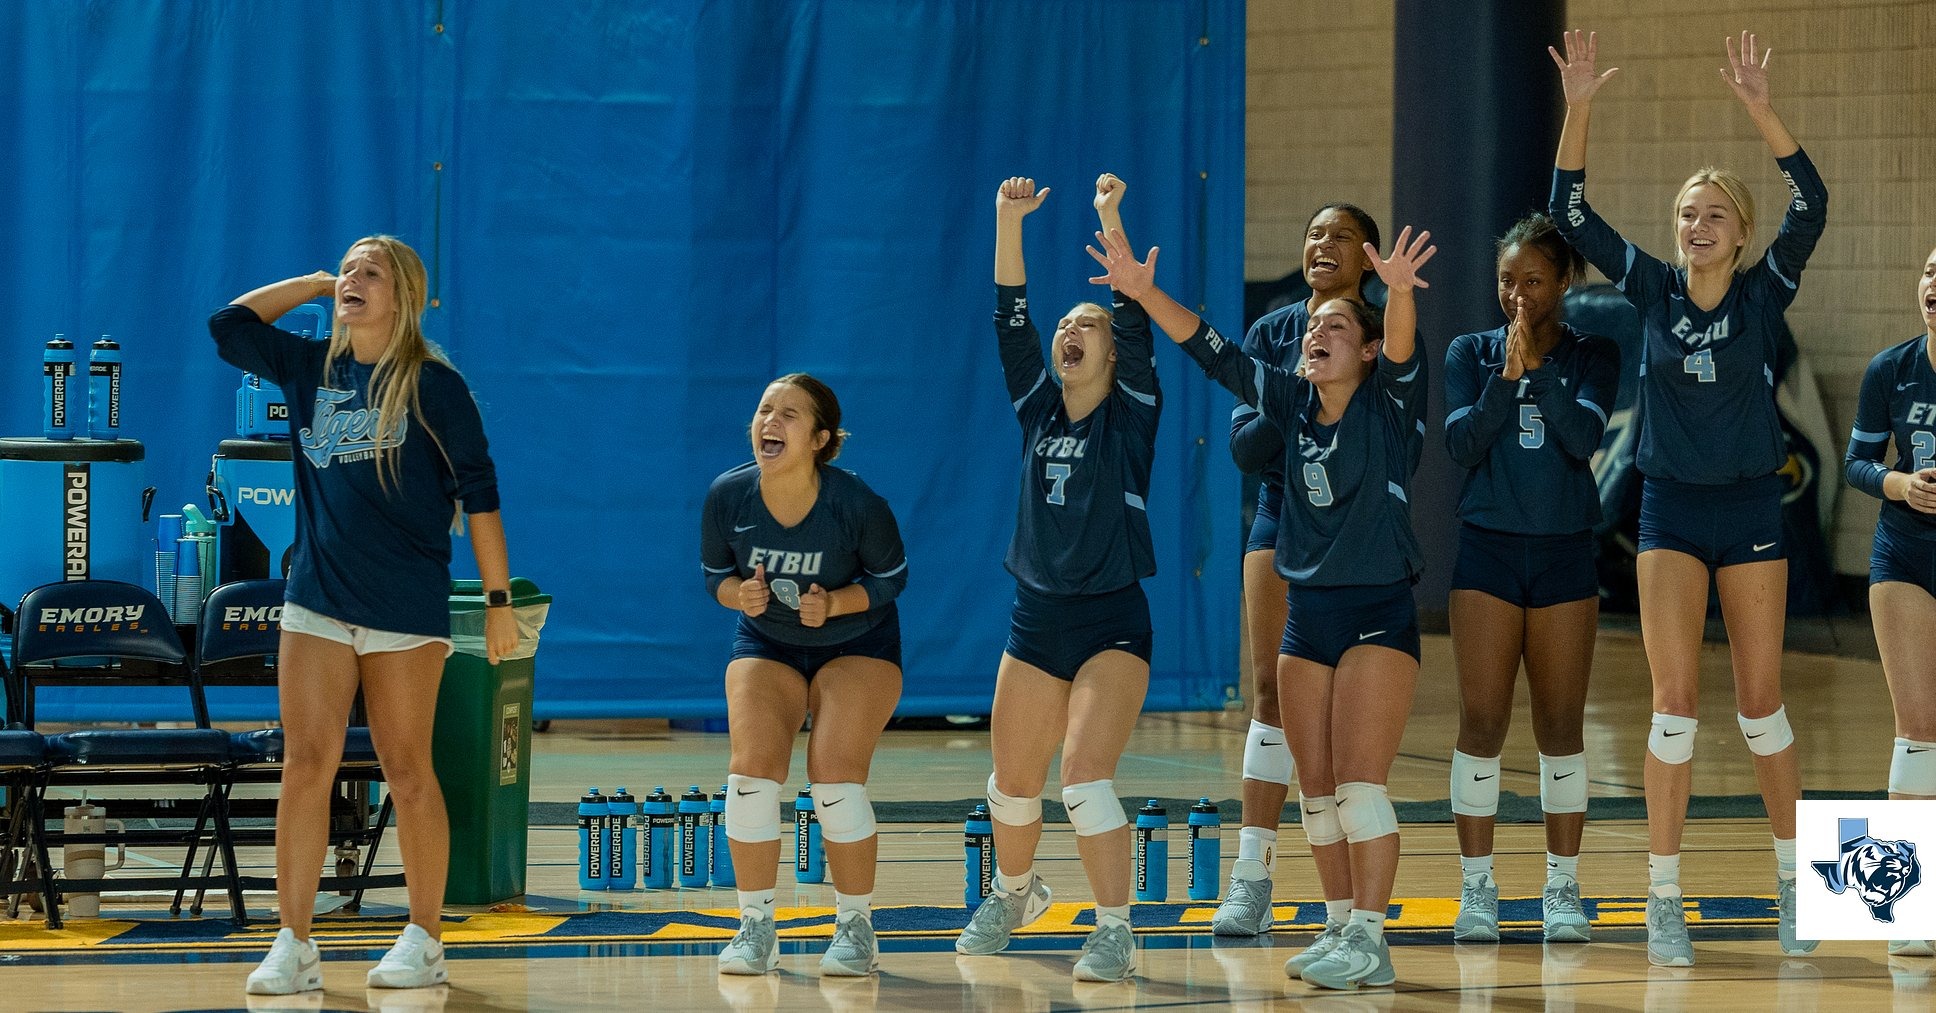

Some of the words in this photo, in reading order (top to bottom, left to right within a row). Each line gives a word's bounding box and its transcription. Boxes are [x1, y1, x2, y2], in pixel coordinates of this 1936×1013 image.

[1200, 326, 1225, 354] PHI
[1683, 348, 1716, 382] 4
[54, 364, 64, 426] POWERADE
[111, 365, 120, 427] POWERADE
[1906, 401, 1936, 426] ET
[1519, 404, 1545, 449] 5
[1046, 463, 1071, 505] 7
[1303, 462, 1334, 507] 9
[67, 472, 87, 581] POWERA
[747, 546, 824, 575] ETBU
[40, 604, 145, 623] EMORY
[224, 606, 284, 622] EMO
[770, 578, 801, 610] 8
[38, 621, 139, 632] EAGLES
[223, 623, 281, 631] EAG
[590, 818, 600, 877] POWERADE
[612, 817, 621, 876] POWERADE
[684, 815, 694, 874] POWERADE
[799, 811, 808, 870] POWERADE
[1138, 830, 1146, 890] POWERADE
[982, 836, 992, 897] POWERADE
